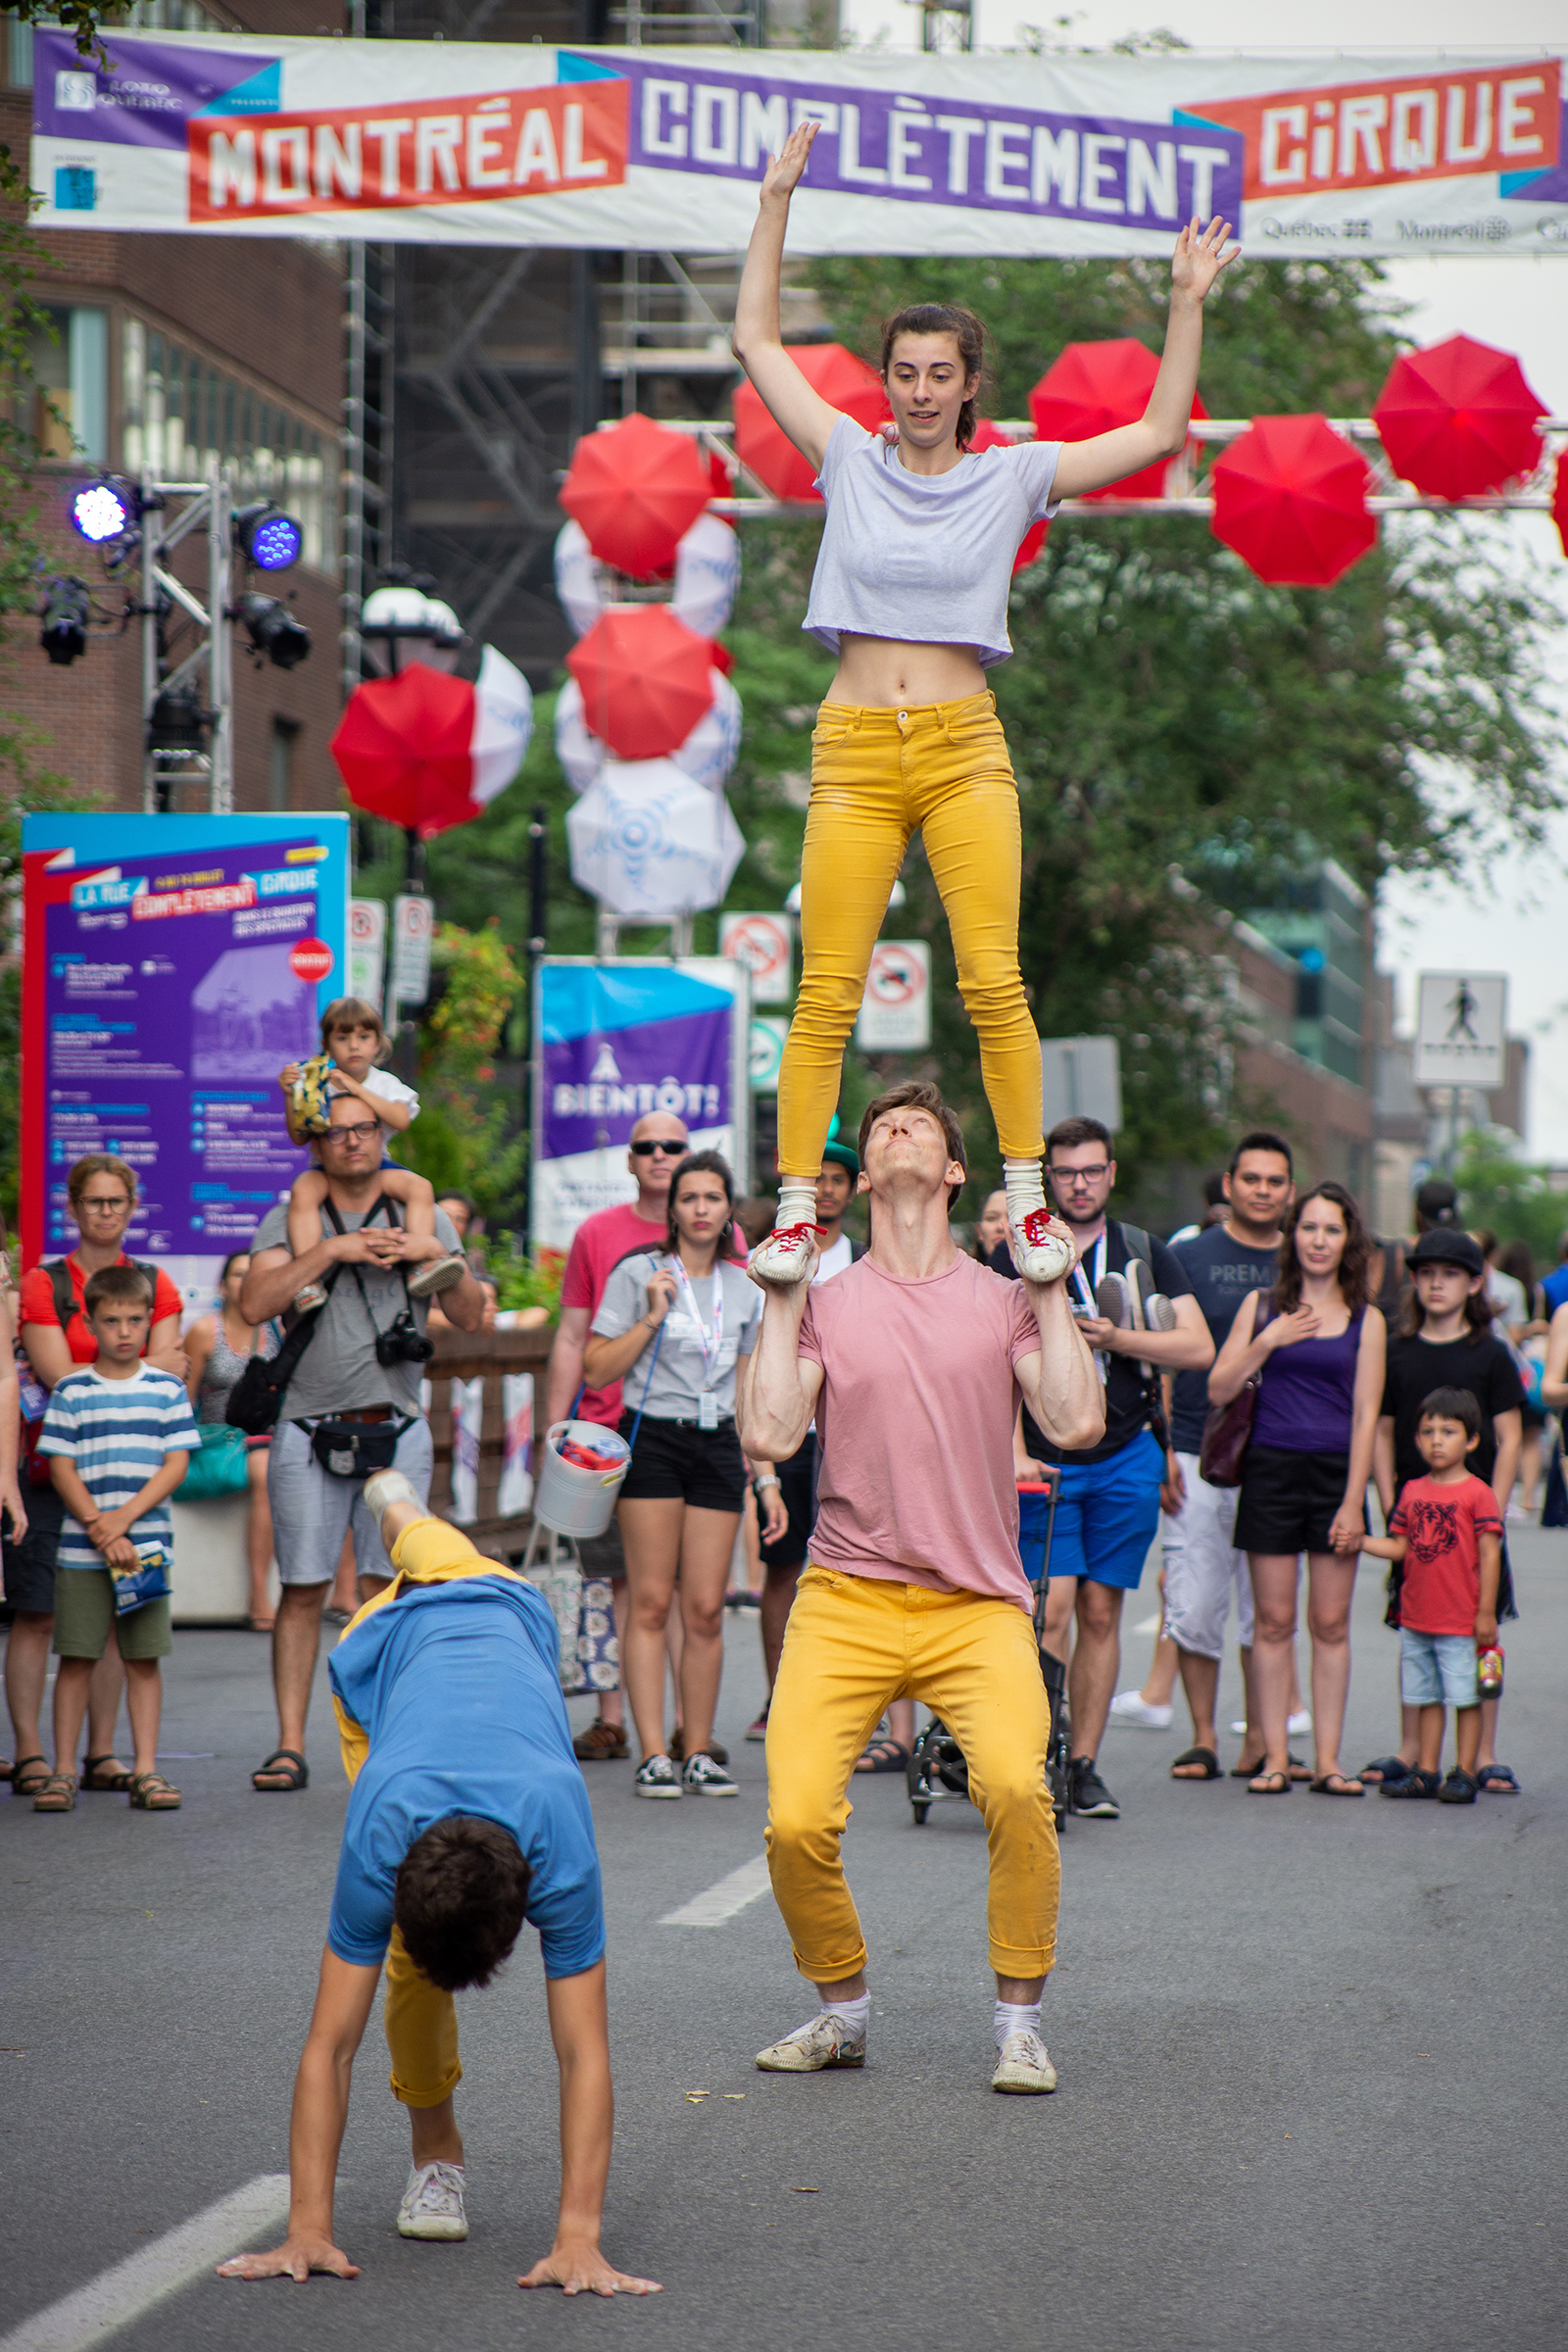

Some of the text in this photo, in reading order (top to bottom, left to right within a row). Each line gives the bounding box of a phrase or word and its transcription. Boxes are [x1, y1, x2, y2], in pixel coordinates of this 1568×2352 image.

[207, 96, 609, 208] MONTRÉAL
[641, 77, 1231, 226] COMPLÈTEMENT
[74, 885, 98, 907] LA
[552, 1075, 720, 1118] BIENTÔT!
